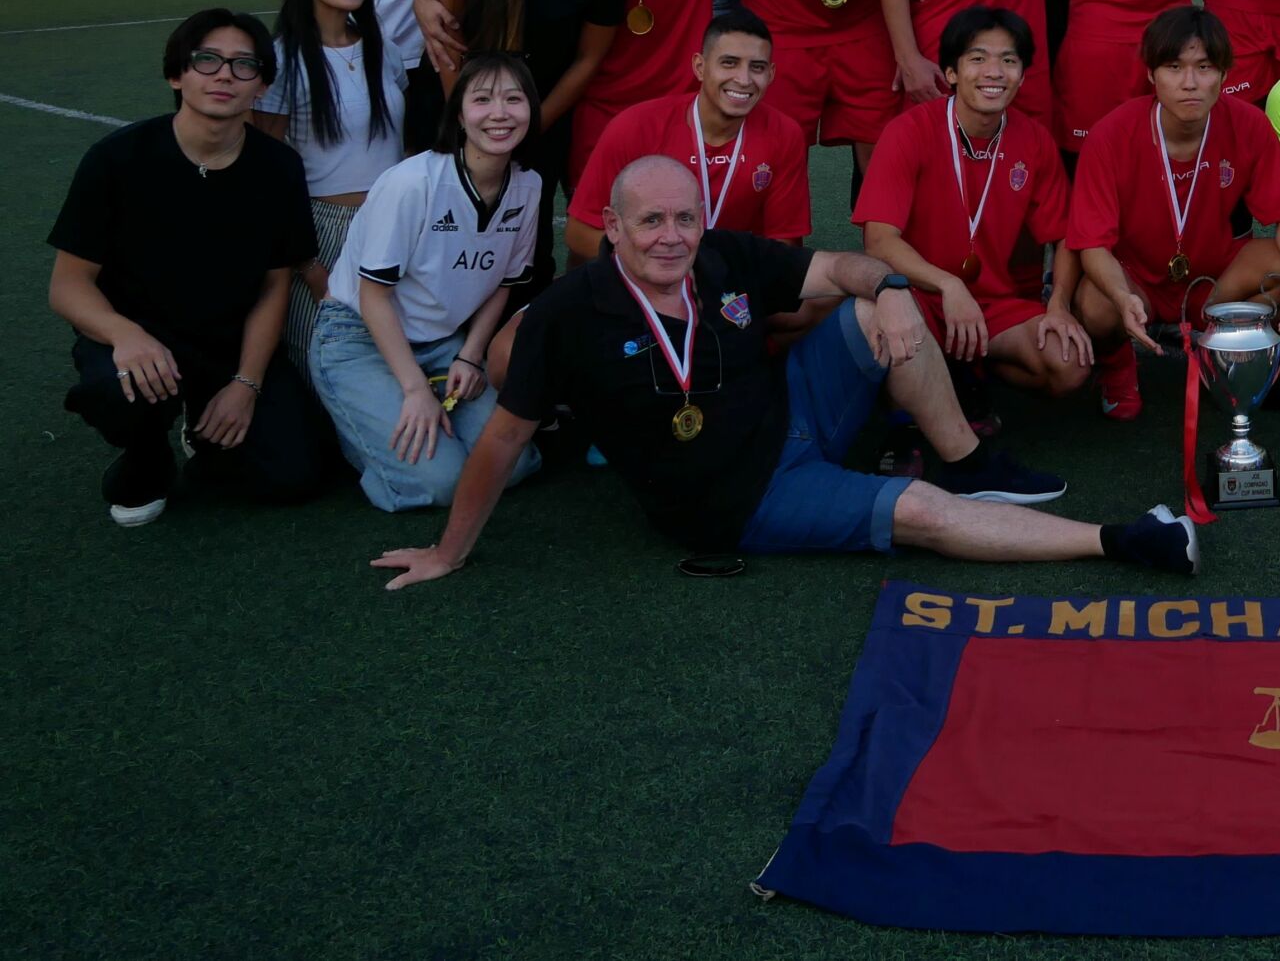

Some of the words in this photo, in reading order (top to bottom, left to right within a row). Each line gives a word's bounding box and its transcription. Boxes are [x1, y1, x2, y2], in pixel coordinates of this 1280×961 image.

[431, 222, 460, 232] adidas
[452, 250, 496, 271] AIG
[901, 591, 1026, 637] ST.
